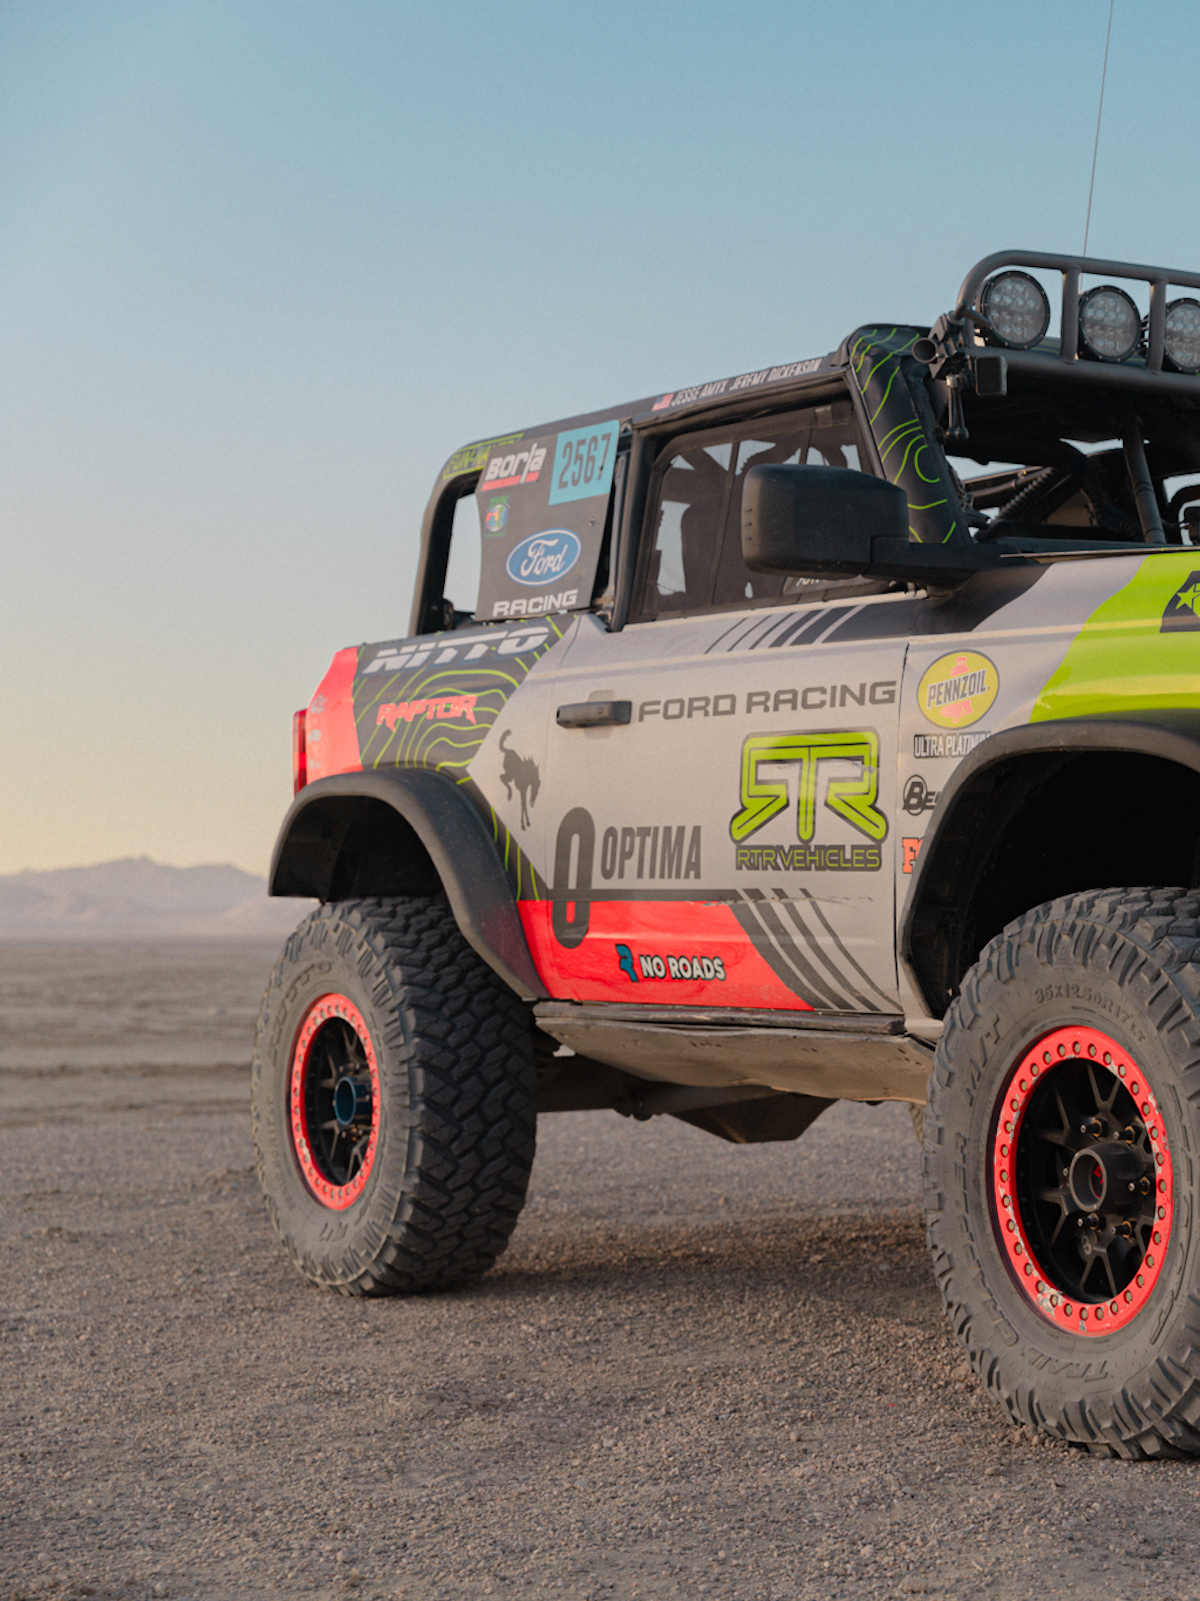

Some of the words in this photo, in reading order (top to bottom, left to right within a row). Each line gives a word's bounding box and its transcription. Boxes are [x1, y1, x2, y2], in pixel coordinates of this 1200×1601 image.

[700, 379, 729, 398] AMYX
[730, 369, 769, 391] JEREMY
[558, 434, 612, 490] 2567
[520, 538, 569, 577] Ford
[492, 589, 578, 617] RACING
[362, 625, 551, 675] NITTO
[638, 693, 737, 723] FORD
[745, 680, 897, 714] RACING
[926, 669, 989, 710] PENNZOIL
[376, 694, 478, 732] RAPTOR
[914, 734, 945, 757] ULTRA
[600, 825, 702, 881] OPTIMA
[779, 848, 881, 868] VEHICLES
[639, 955, 667, 979] NO
[667, 955, 727, 982] ROADS
